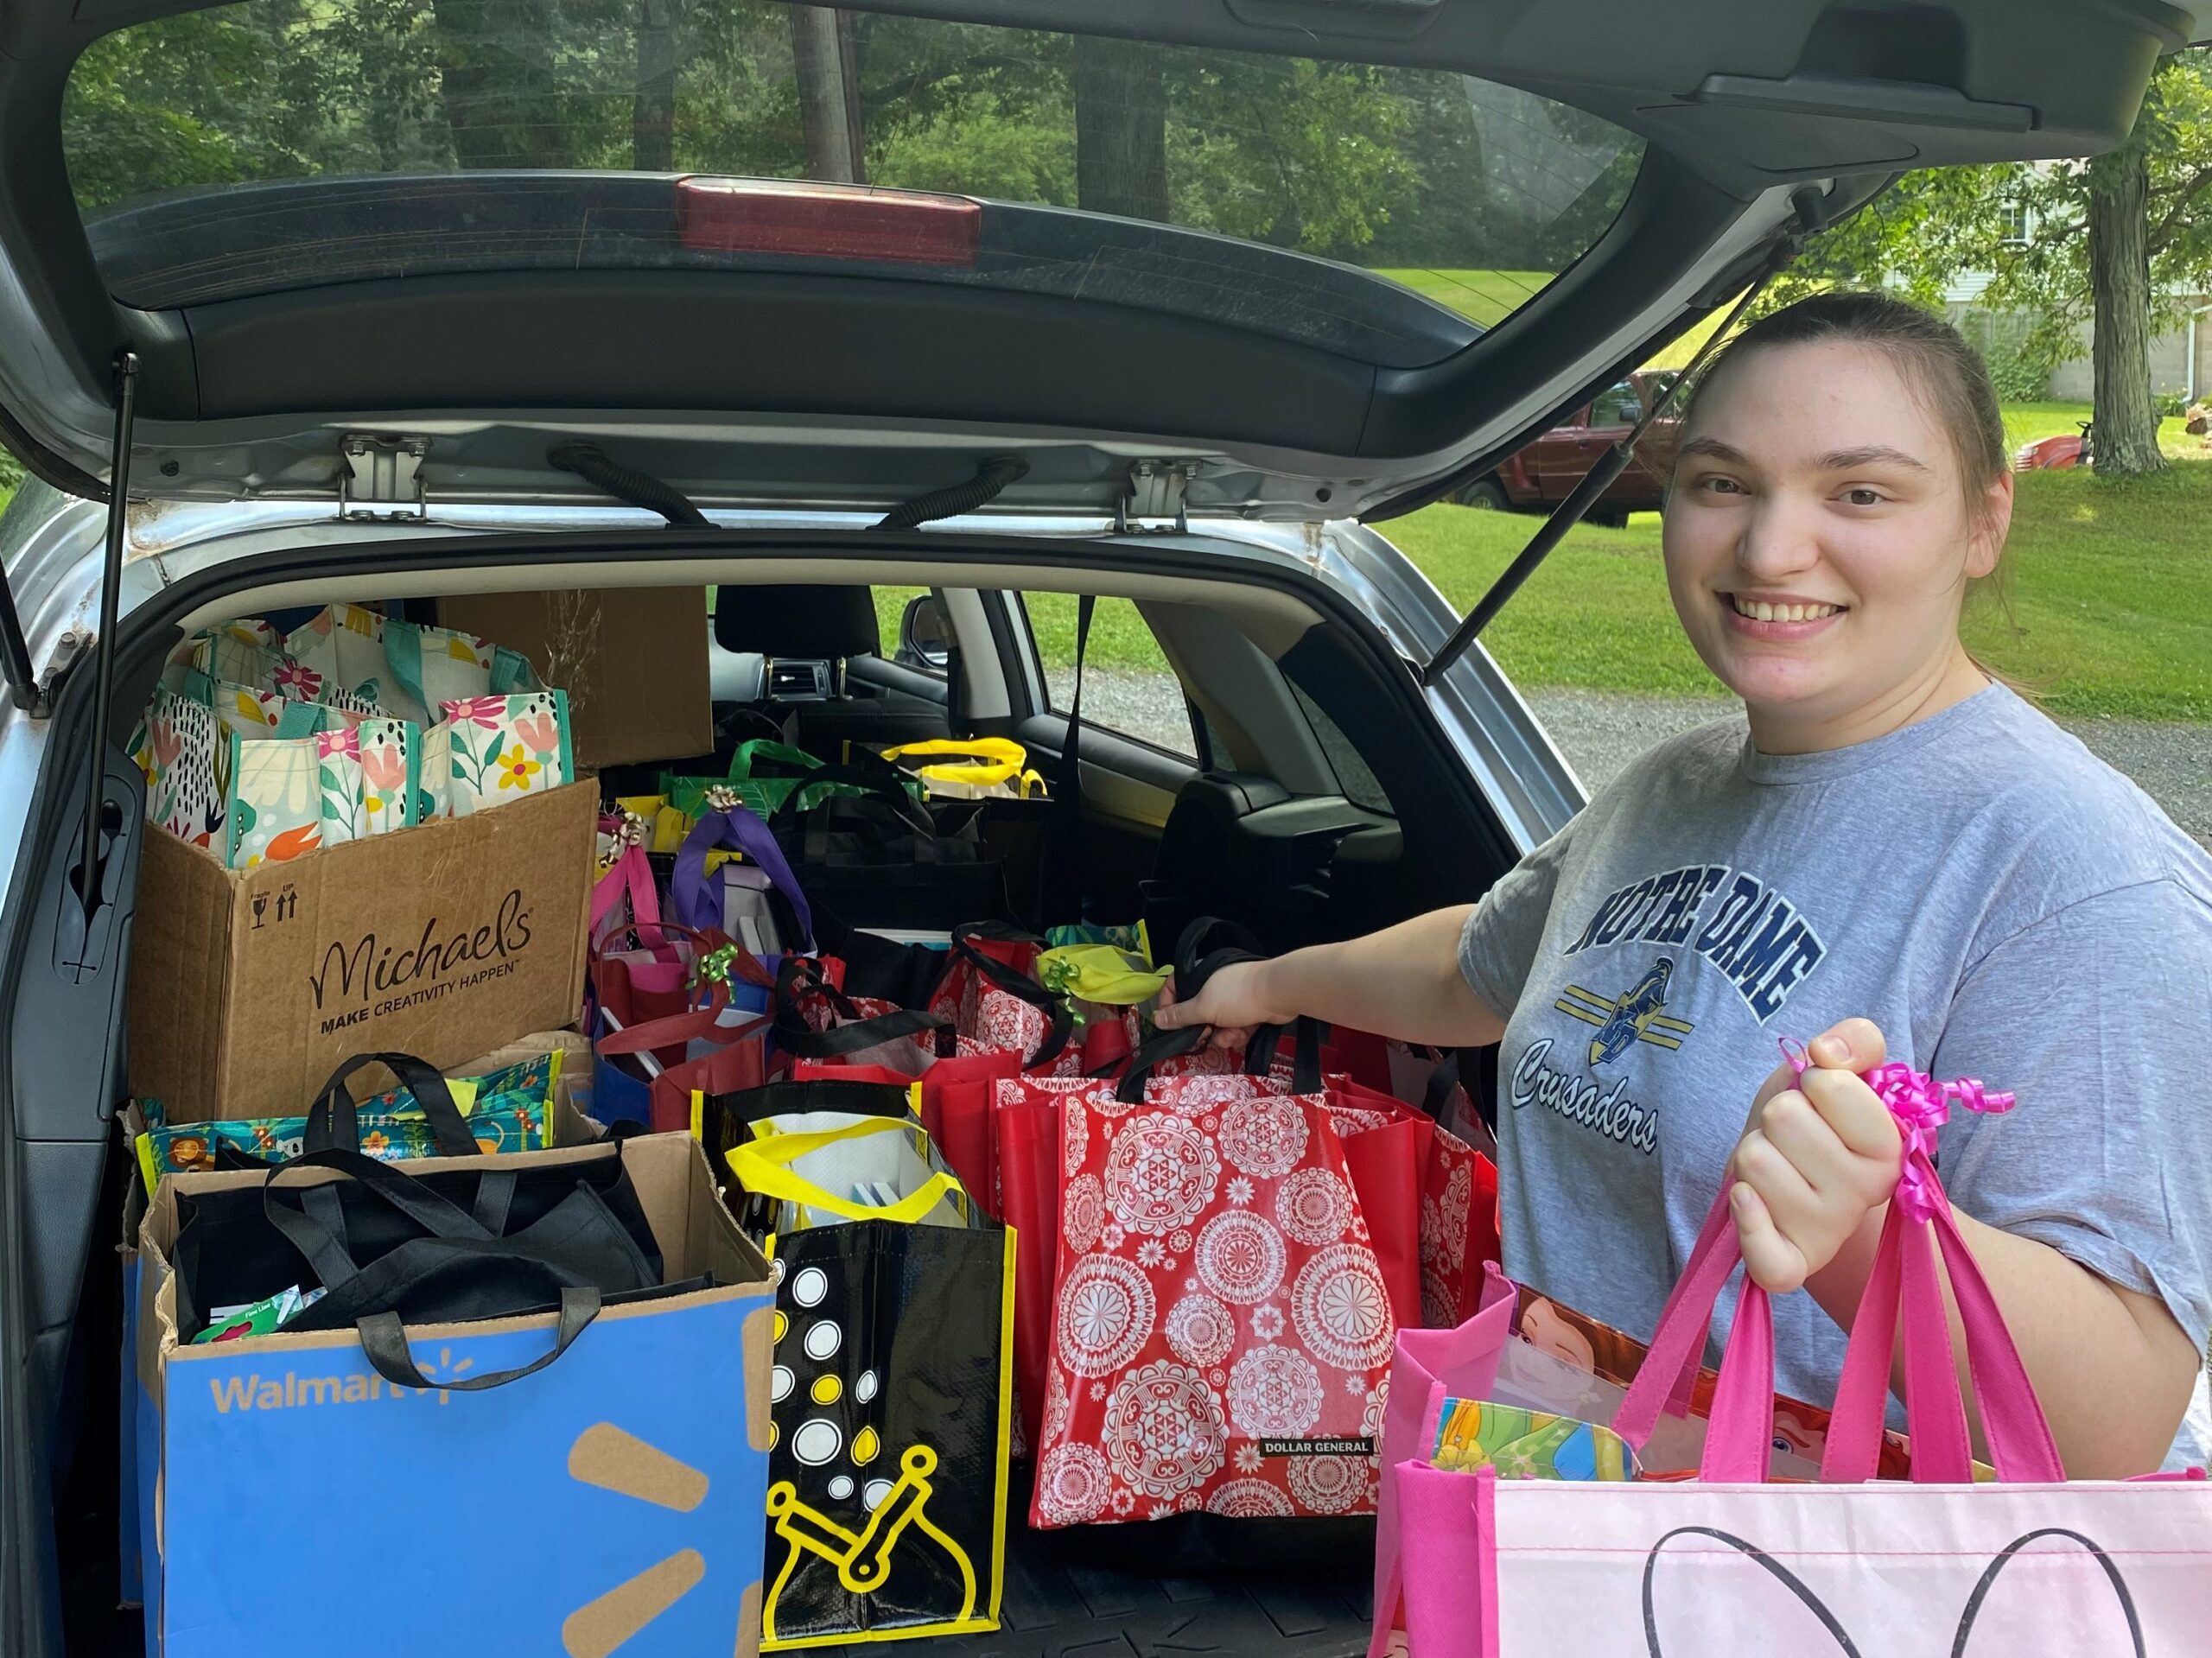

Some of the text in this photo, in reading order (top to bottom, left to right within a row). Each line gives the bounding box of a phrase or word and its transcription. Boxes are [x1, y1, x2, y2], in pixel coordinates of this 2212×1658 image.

[283, 883, 294, 893] UP
[309, 889, 531, 1009] Michaels
[1562, 863, 1827, 1027] NOTRE DAME
[321, 1007, 370, 1035] MAKE
[374, 981, 456, 1017] CREATIVITY
[1512, 1039, 1659, 1155] Crusaders
[1265, 1441, 1369, 1453] DOLLAR GENERAL
